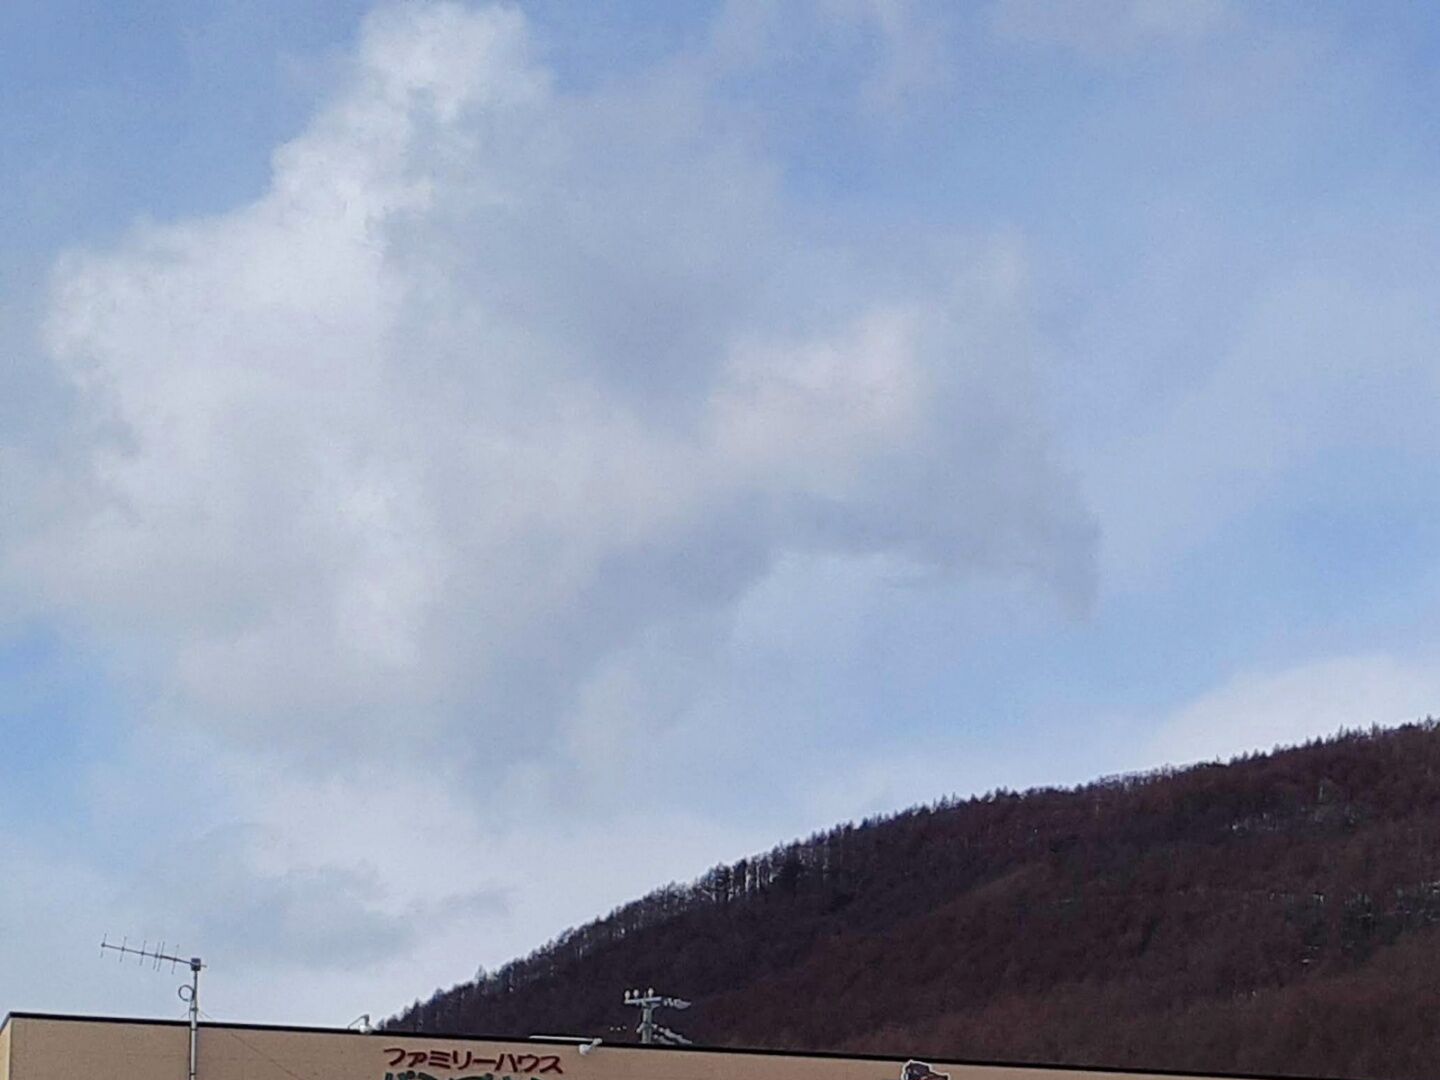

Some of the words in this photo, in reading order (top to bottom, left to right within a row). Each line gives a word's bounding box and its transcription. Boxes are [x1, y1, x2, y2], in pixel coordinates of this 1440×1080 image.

[384, 1048, 564, 1074] ファミリーハウス
